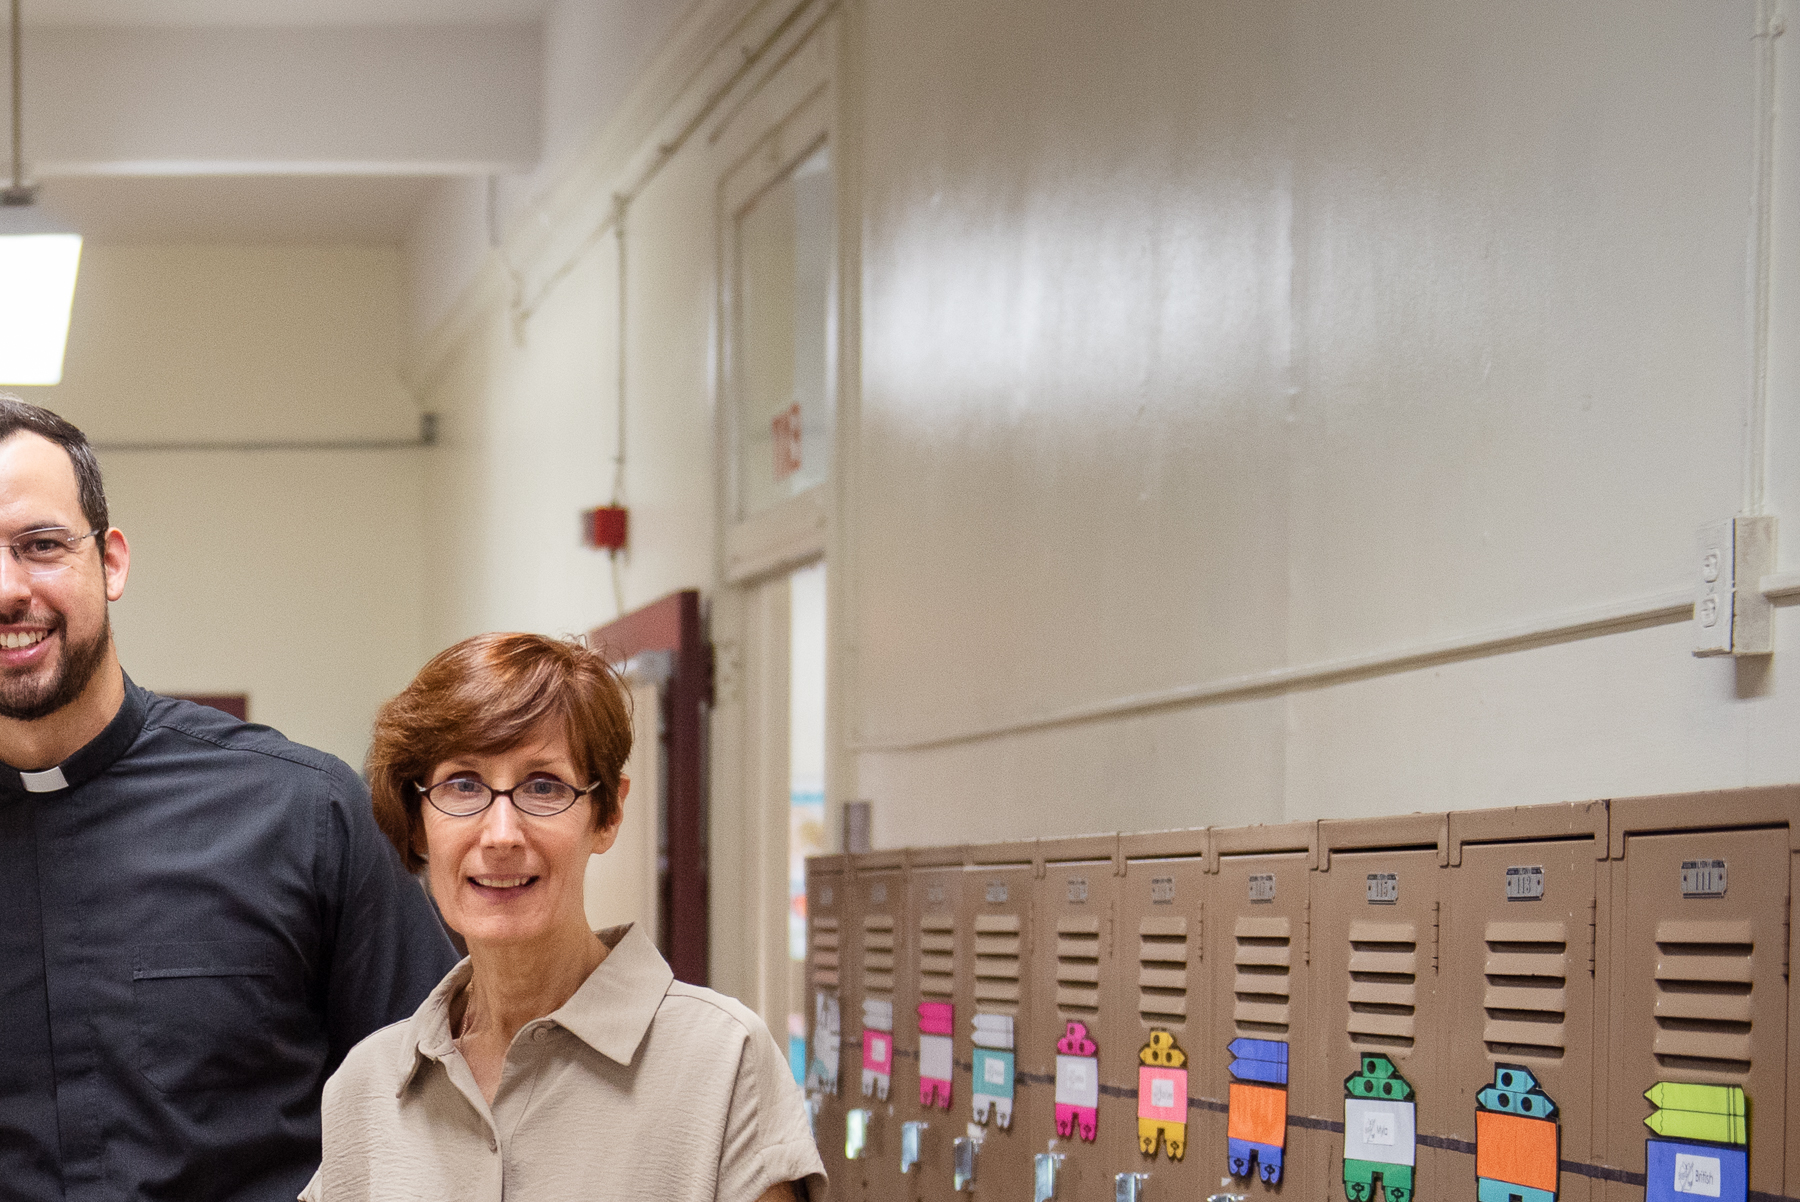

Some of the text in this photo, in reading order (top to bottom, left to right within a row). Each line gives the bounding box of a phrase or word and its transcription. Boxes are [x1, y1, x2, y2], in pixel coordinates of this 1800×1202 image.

[1517, 875, 1532, 894] 113
[1696, 871, 1711, 890] 111
[1695, 1169, 1714, 1185] British
